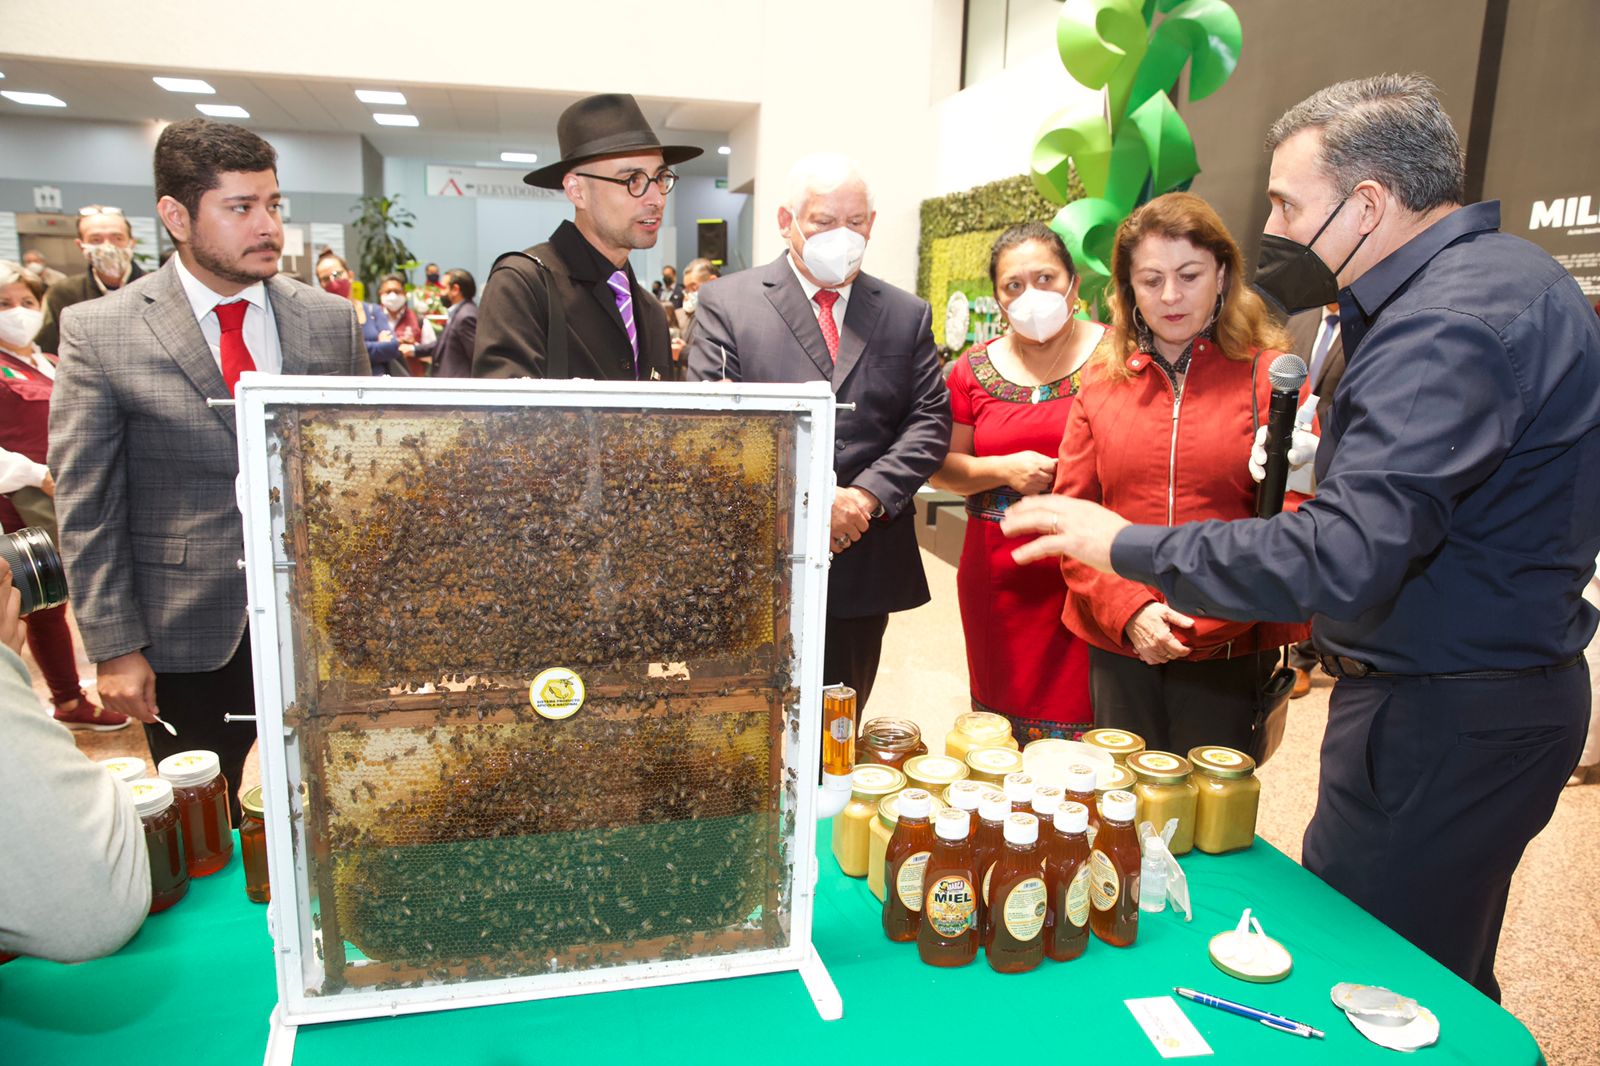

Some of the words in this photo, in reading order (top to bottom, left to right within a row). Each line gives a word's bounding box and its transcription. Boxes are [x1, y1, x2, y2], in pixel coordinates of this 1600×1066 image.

[476, 184, 556, 198] ELEVADORES
[1529, 195, 1600, 230] MIL
[934, 892, 972, 904] MIEL
